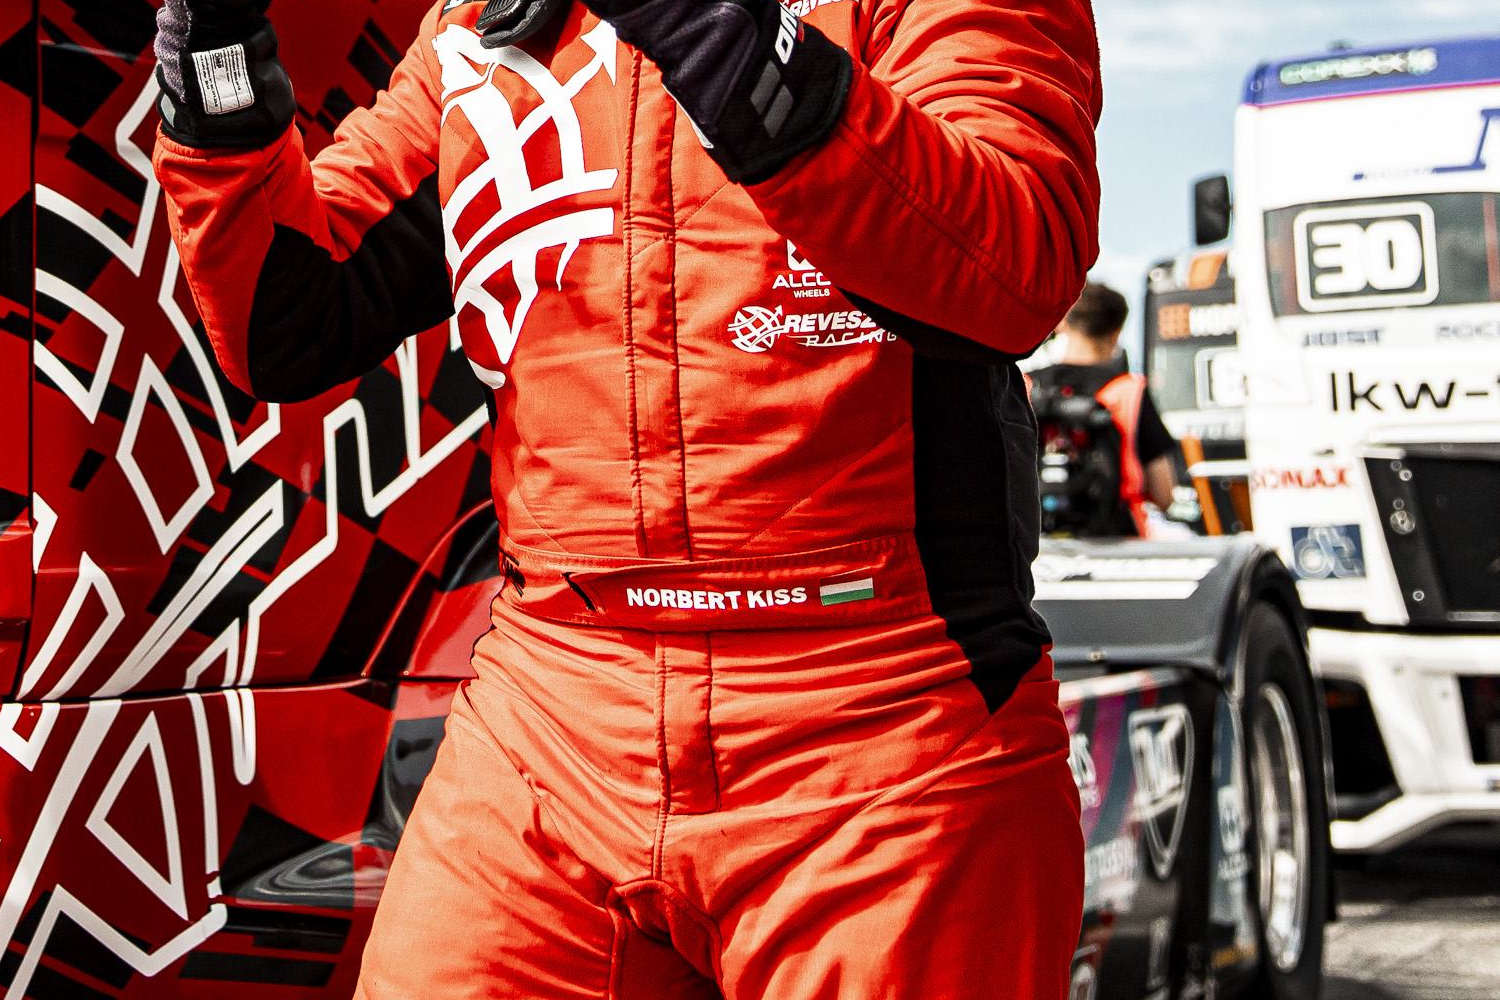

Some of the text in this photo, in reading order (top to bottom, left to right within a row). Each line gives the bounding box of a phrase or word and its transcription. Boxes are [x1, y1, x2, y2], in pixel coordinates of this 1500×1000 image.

[1311, 218, 1424, 297] 30
[793, 288, 831, 298] WHEELS
[1329, 371, 1500, 412] lkw-
[626, 587, 808, 610] NORBERT KISS
